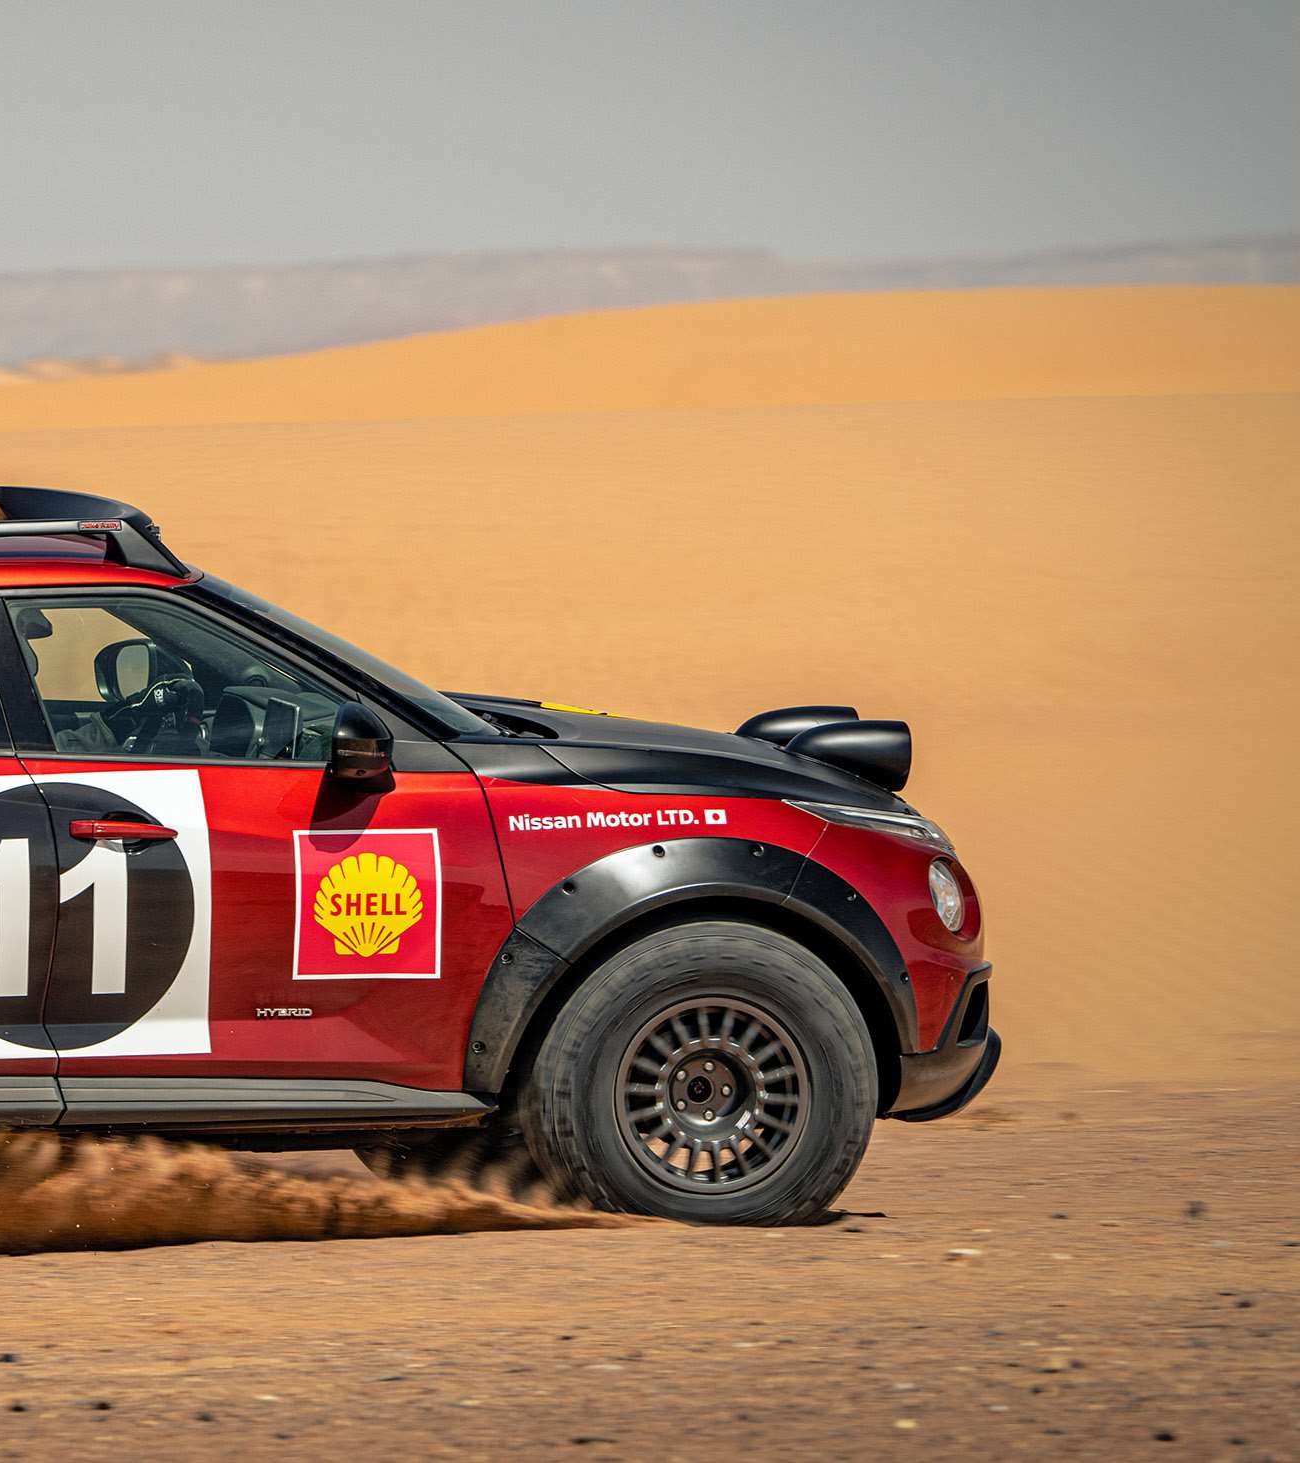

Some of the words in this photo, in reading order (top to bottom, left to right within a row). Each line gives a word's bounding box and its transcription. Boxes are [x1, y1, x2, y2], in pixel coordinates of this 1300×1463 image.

[508, 814, 582, 831] Nissan
[586, 811, 652, 828] Motor
[656, 809, 699, 826] LTD.
[330, 893, 407, 916] SHELL
[256, 1008, 312, 1017] HYBRID
